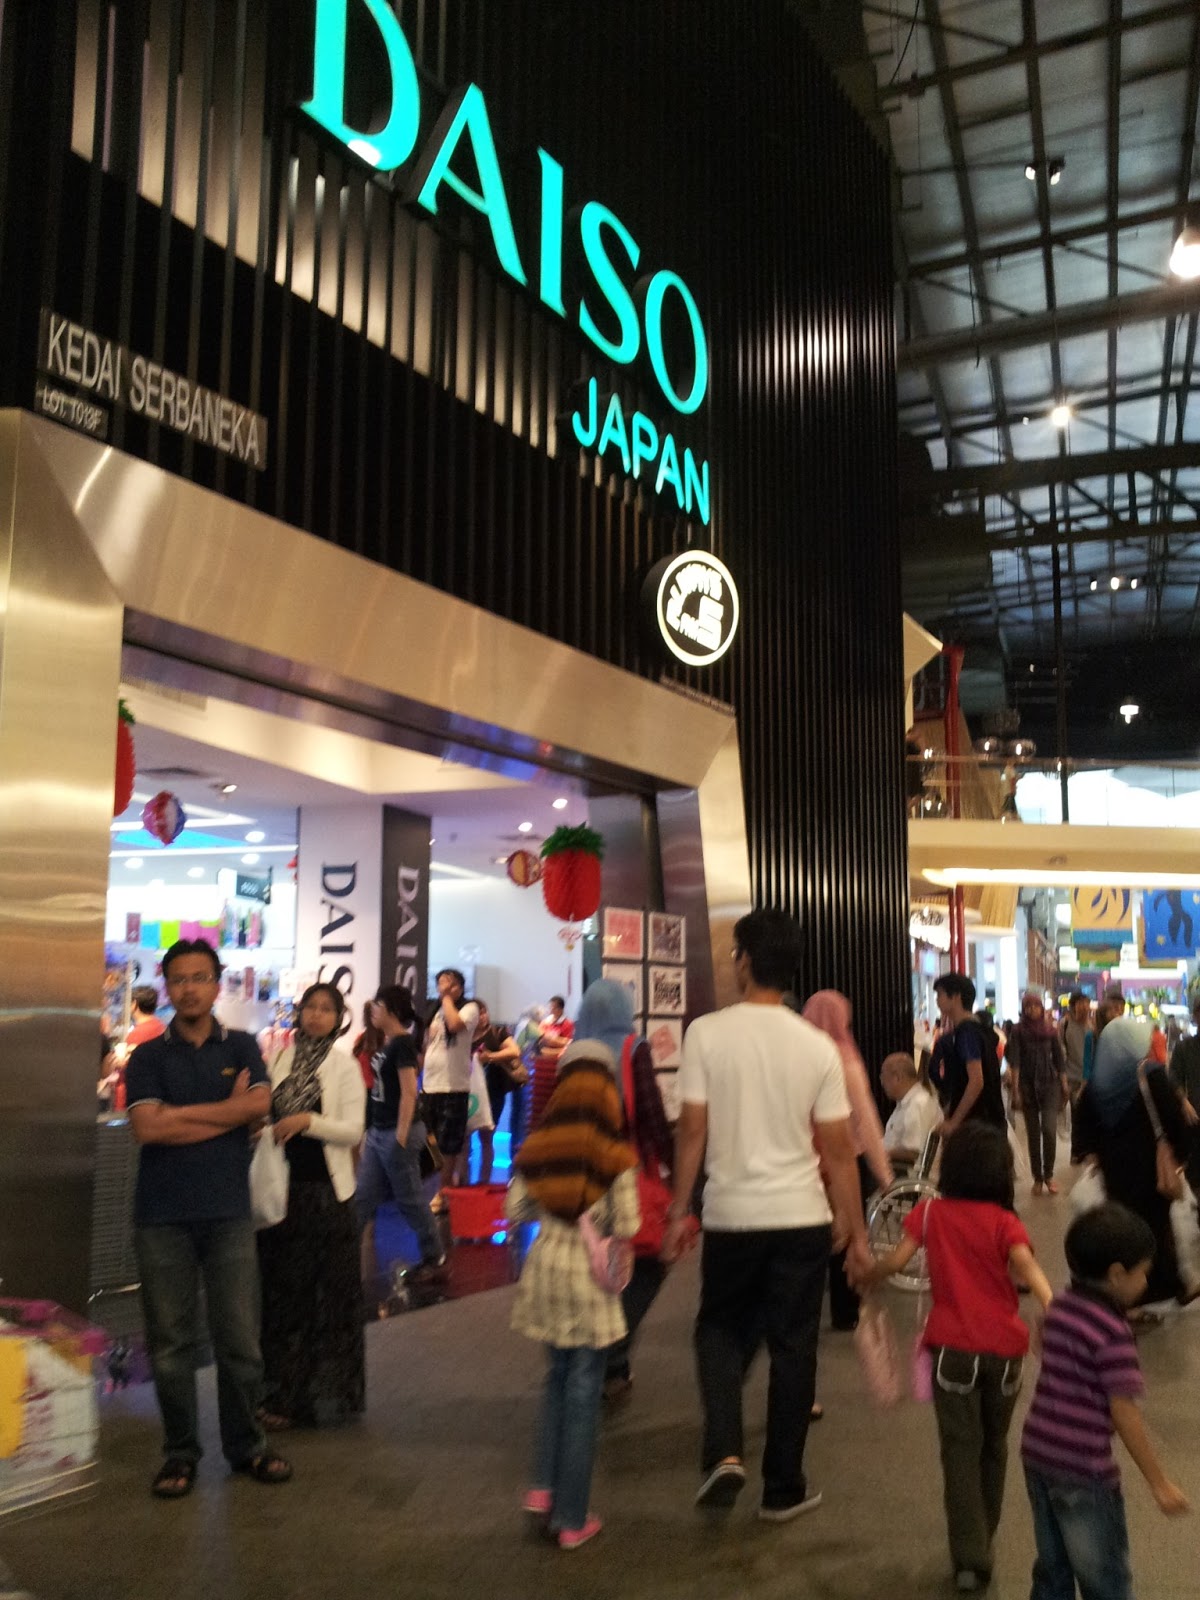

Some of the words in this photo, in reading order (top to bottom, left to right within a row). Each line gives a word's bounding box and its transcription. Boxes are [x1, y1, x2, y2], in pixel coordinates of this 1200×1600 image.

[300, 0, 709, 415] DAISO
[47, 313, 122, 400] KEDAI
[129, 354, 260, 466] SERBANEKA
[571, 376, 711, 526] JAPAN
[395, 865, 420, 1036] DAIS
